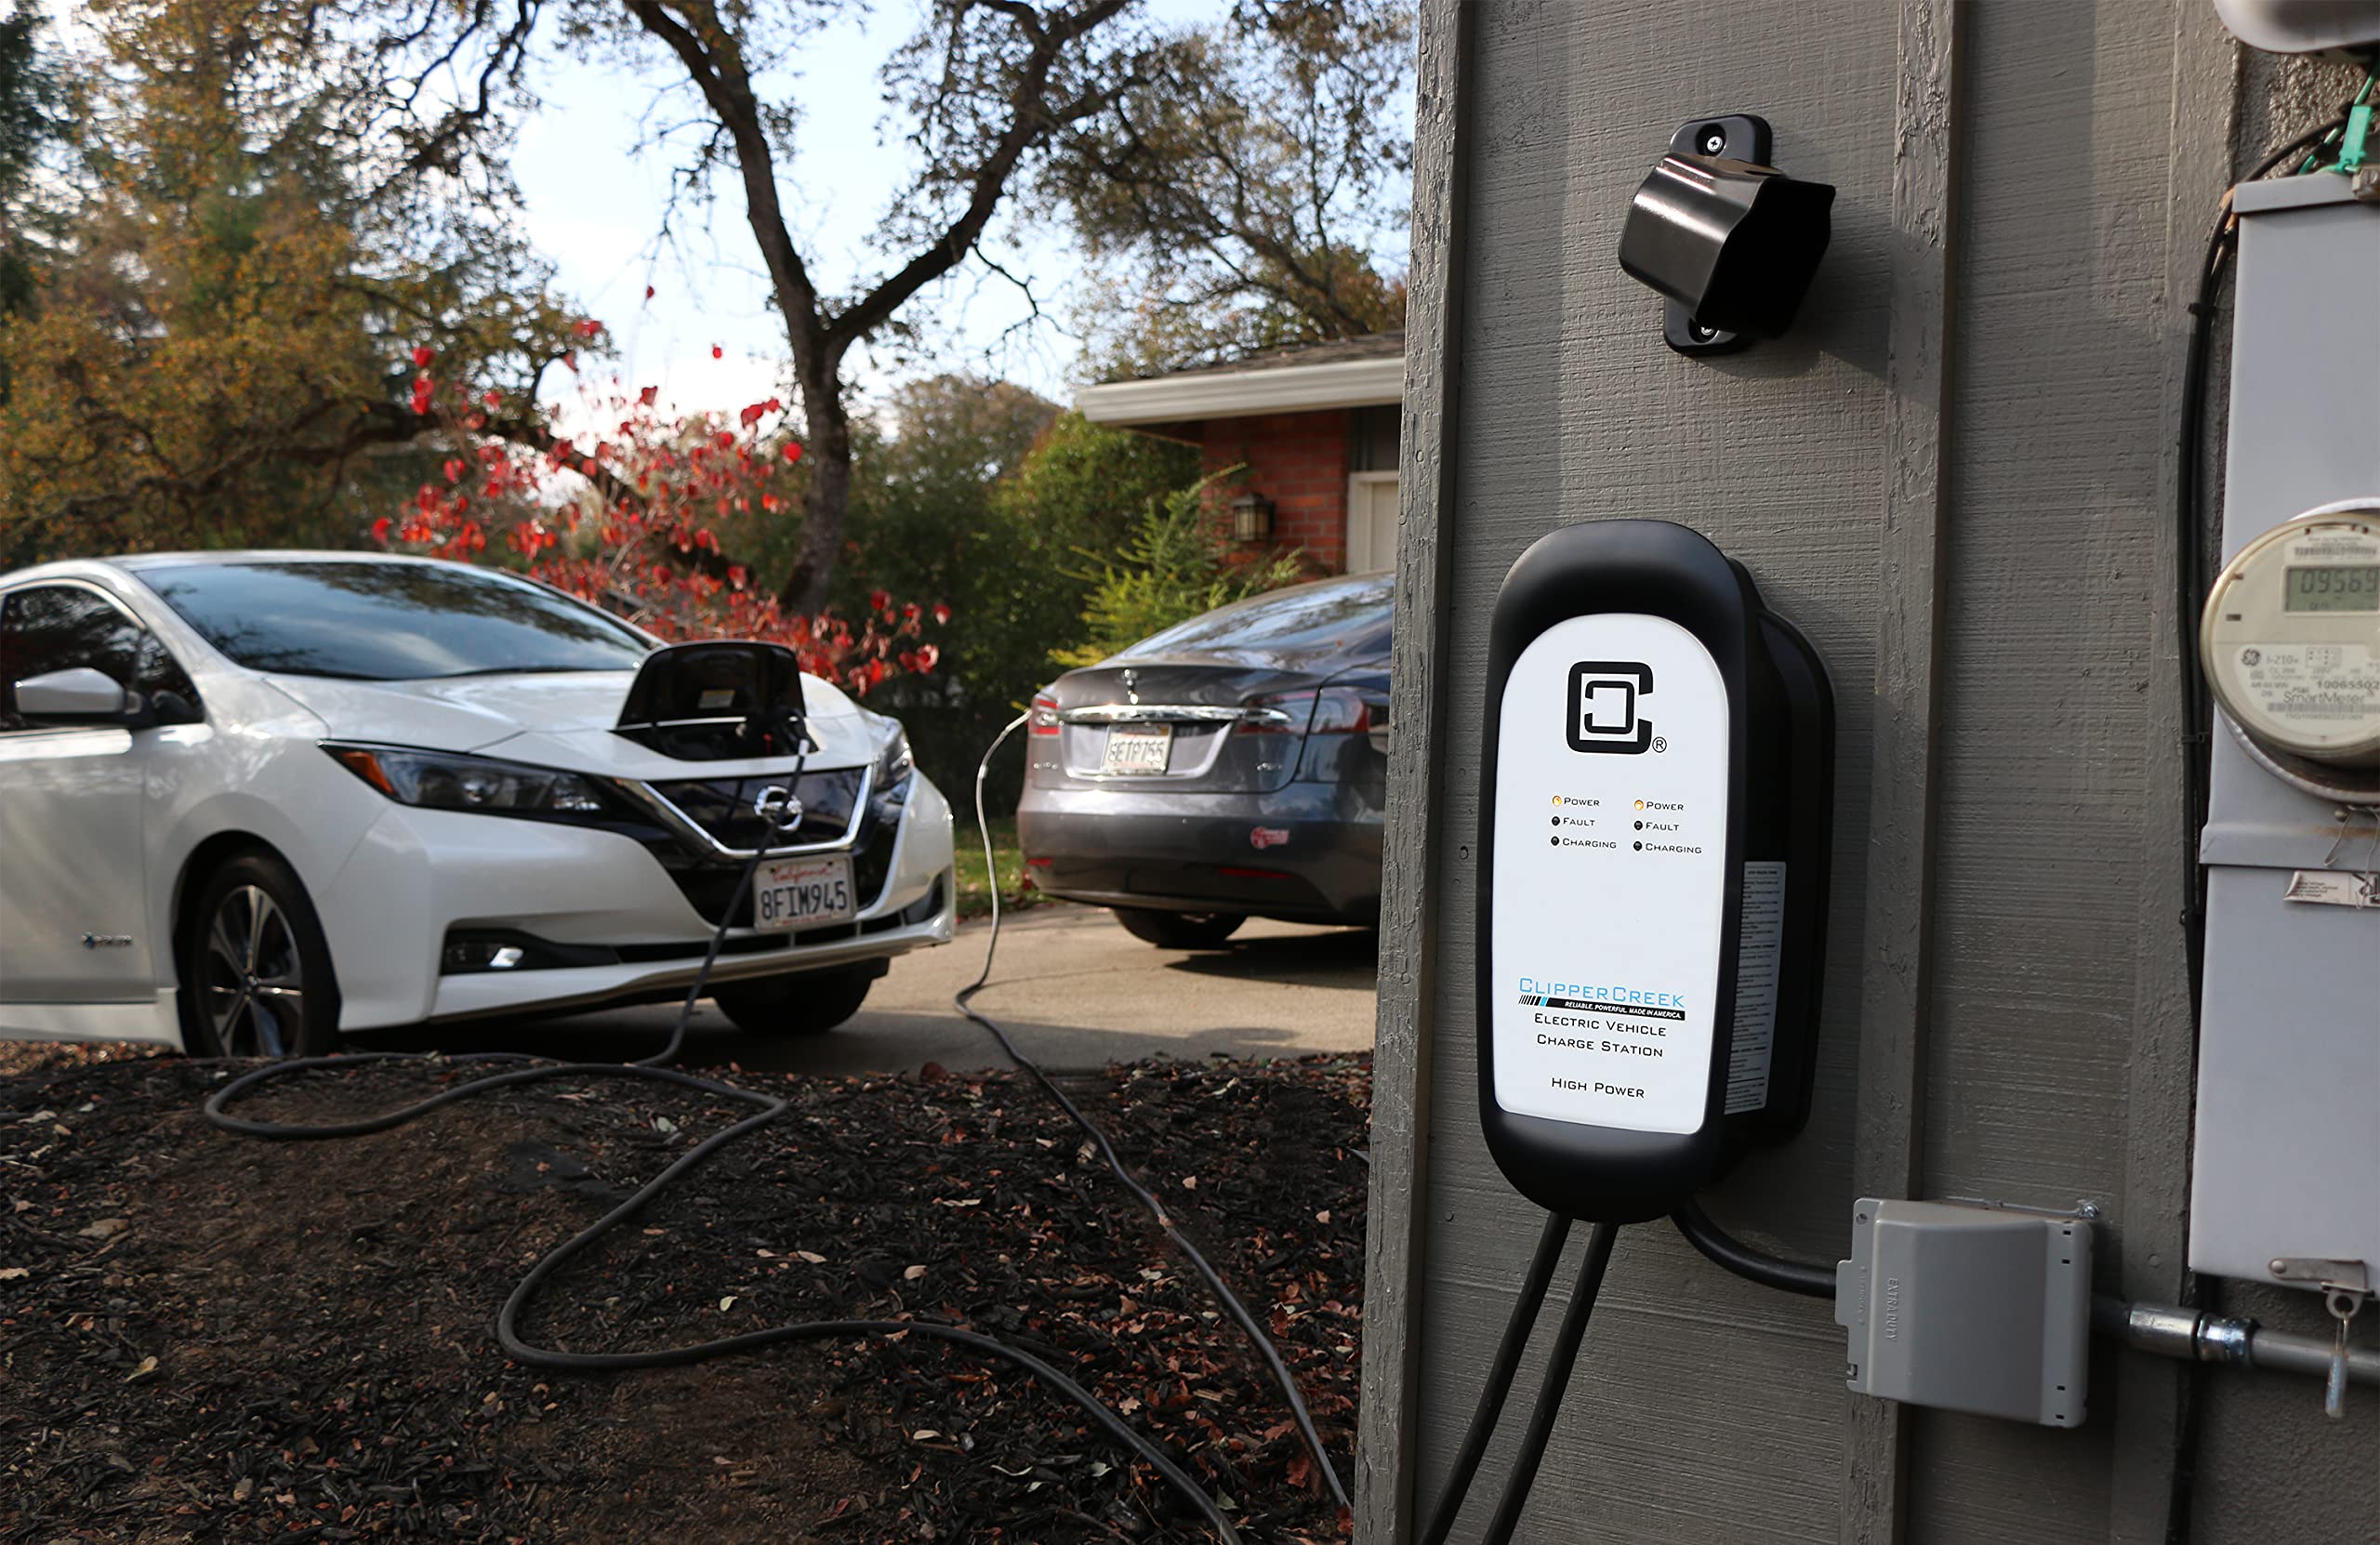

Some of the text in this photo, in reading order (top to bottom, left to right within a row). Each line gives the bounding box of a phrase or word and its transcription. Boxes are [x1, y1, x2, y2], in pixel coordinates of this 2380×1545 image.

[1564, 798, 1600, 807] POWER
[1646, 801, 1685, 811] POWER
[1563, 817, 1595, 826] FAULT
[1646, 822, 1680, 831] FAULT
[1562, 838, 1617, 849] CHARGING
[1646, 842, 1702, 854] CHARGING
[760, 880, 847, 920] 8FIM945
[1534, 1012, 1667, 1037] ELECTRIC VEHICLE
[1537, 1034, 1663, 1058] CHARGE STATION
[1552, 1076, 1645, 1099] HIGH POWER
[1885, 1277, 1898, 1340] EXTRA DUTY
